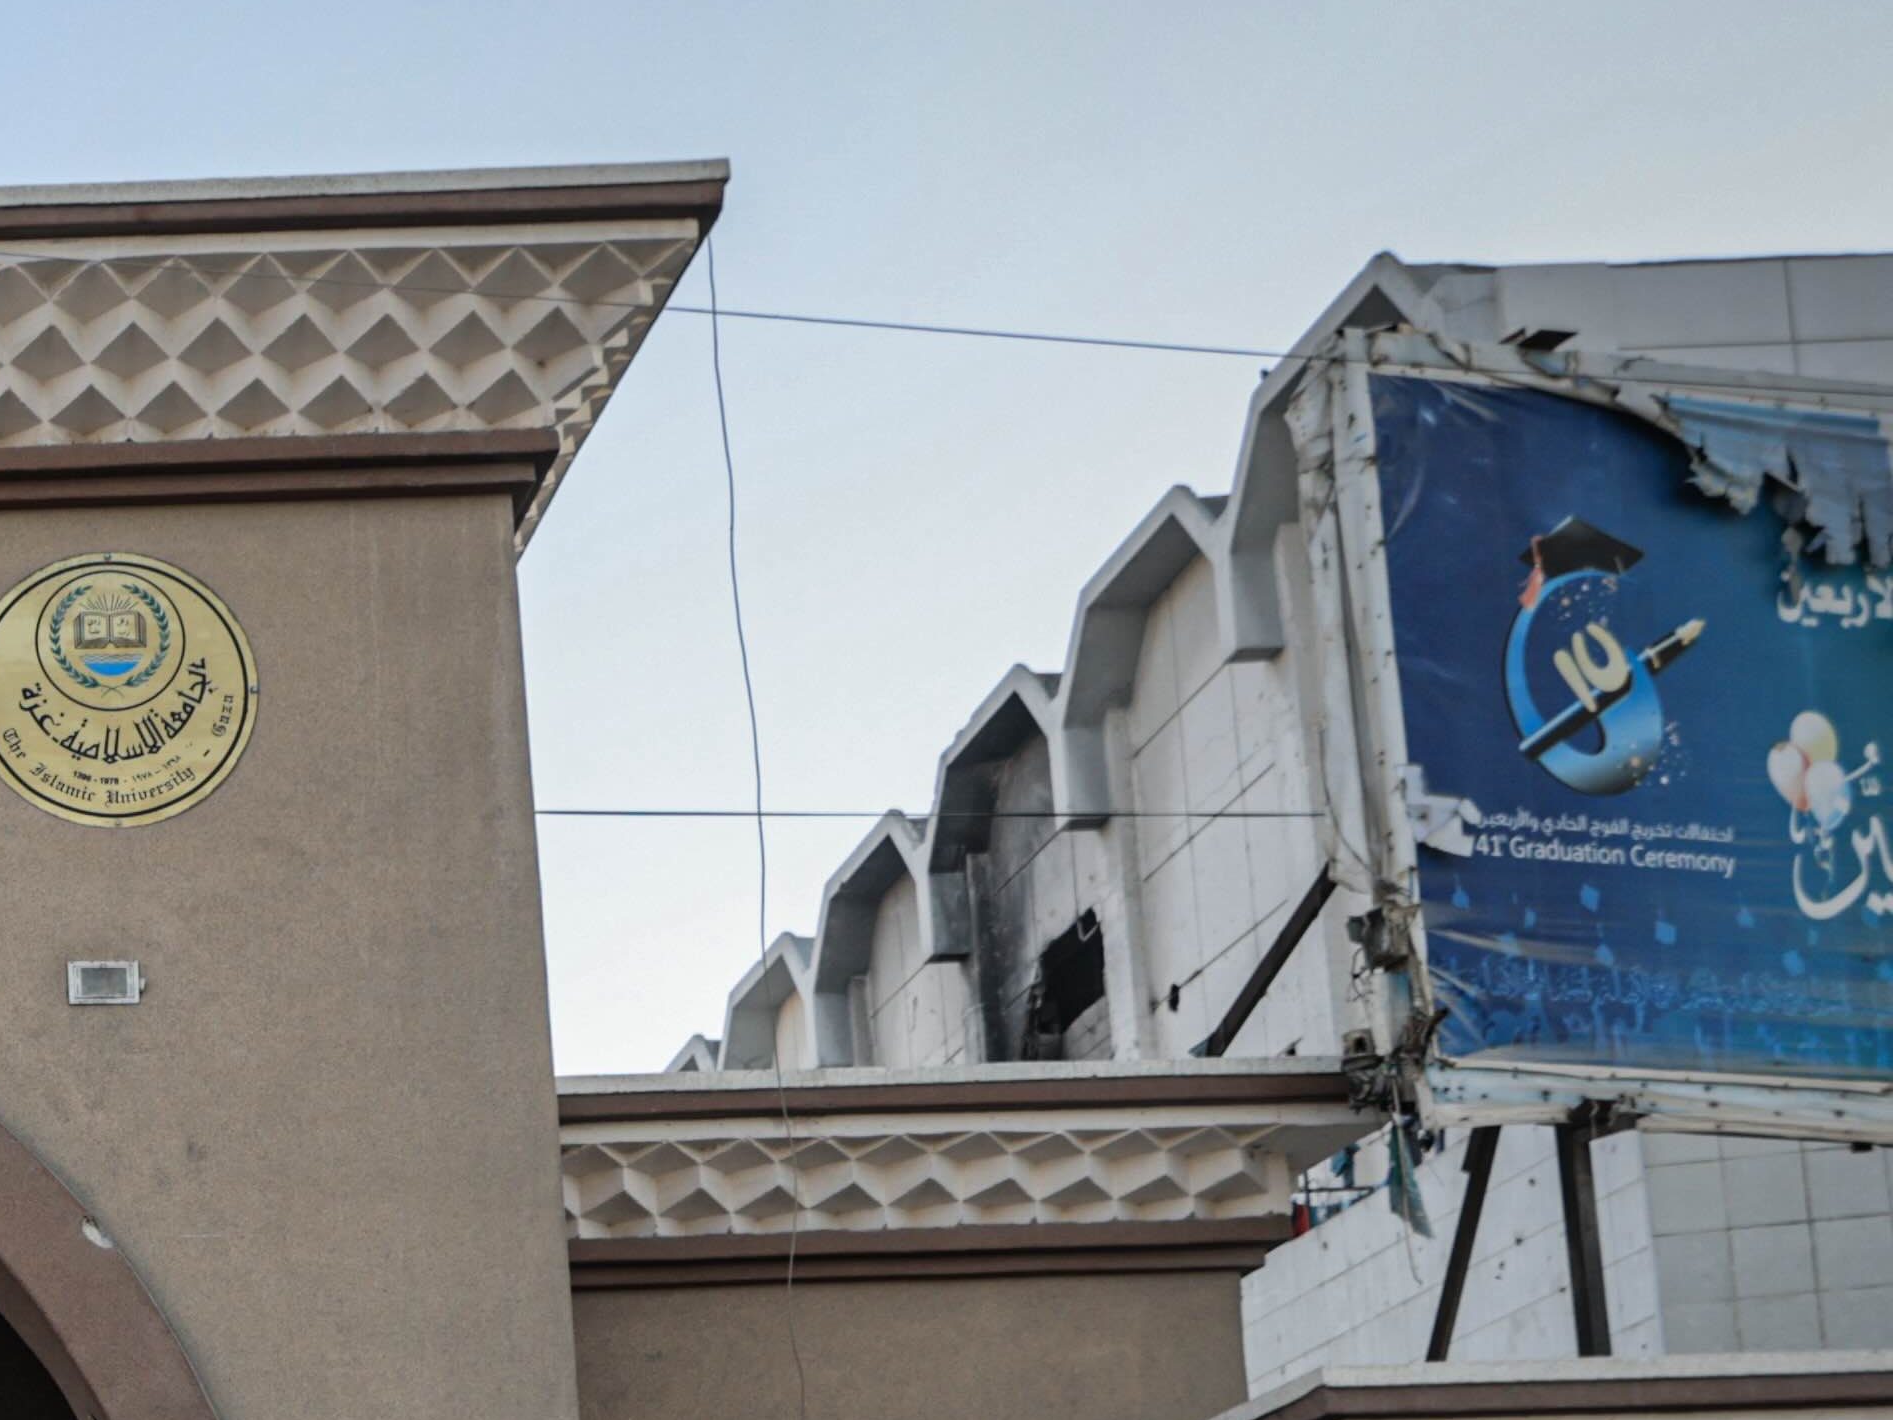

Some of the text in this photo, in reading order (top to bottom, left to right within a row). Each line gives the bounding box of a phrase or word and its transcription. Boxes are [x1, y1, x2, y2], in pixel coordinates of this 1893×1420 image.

[19, 682, 65, 736] غزة
[149, 657, 215, 740] الجامعة
[3, 728, 26, 758] The
[29, 763, 96, 801] Islamic
[105, 767, 196, 808] University
[211, 694, 234, 737] Gaza
[1509, 835, 1626, 865] Graduation
[1630, 843, 1736, 879] Ceremony
